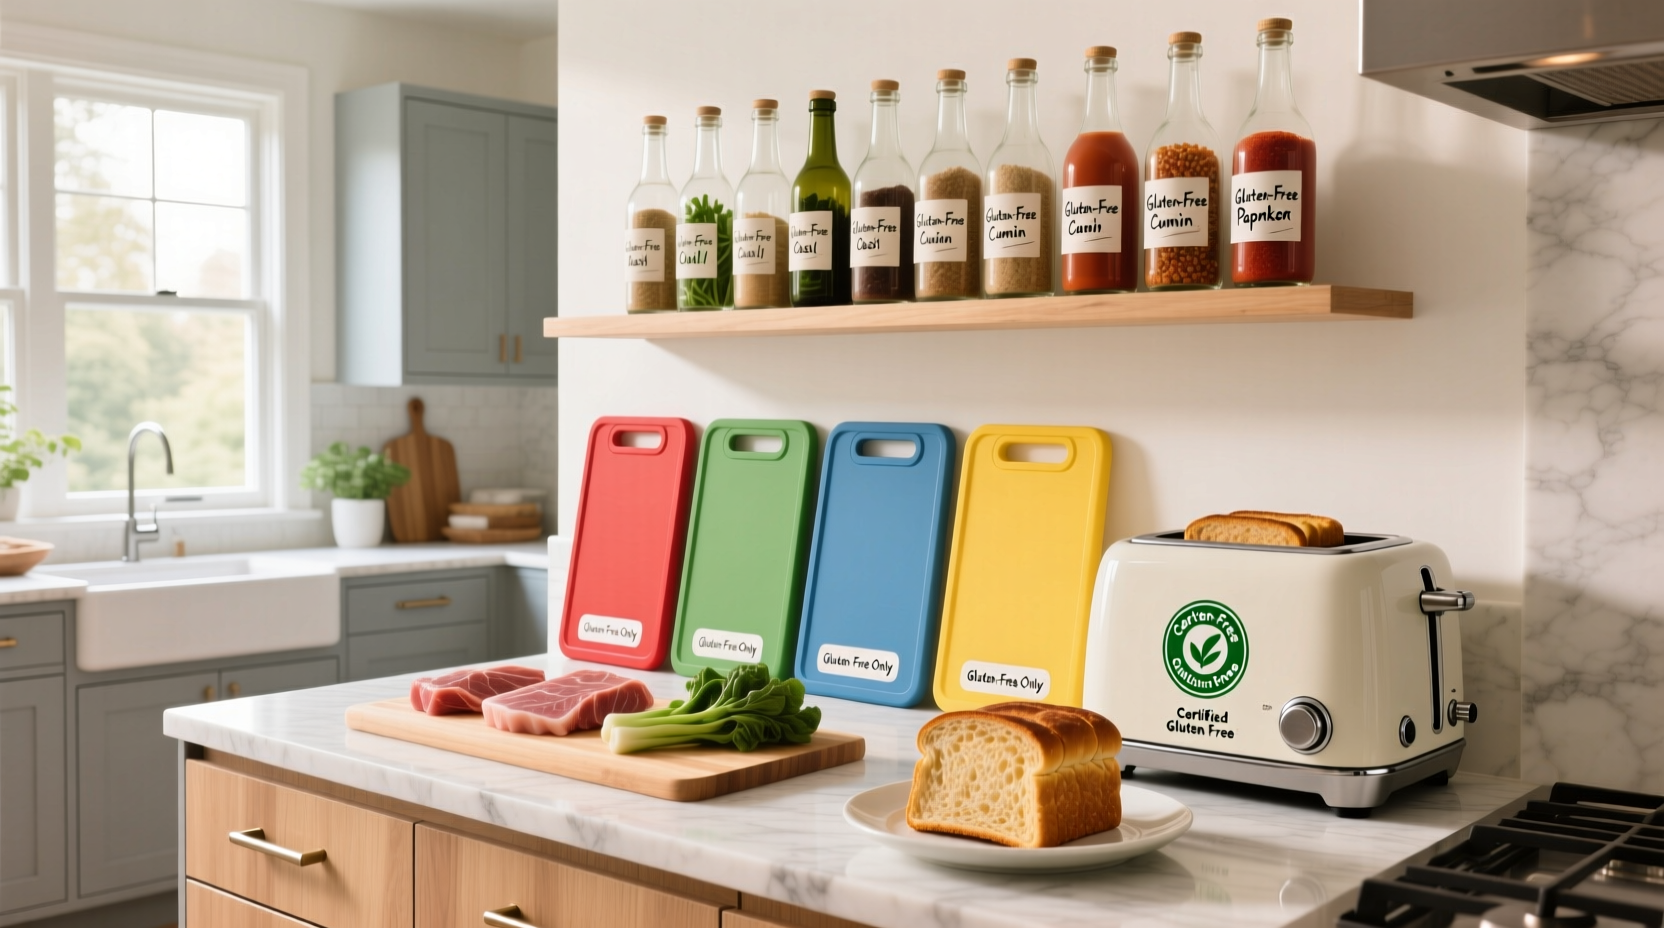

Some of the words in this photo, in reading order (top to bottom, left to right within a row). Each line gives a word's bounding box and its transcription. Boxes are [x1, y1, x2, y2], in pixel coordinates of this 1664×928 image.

[1146, 191, 1208, 211] Gluten-Free
[1235, 184, 1300, 206] Gluten-Free
[1150, 212, 1194, 231] Cumin
[988, 225, 1027, 242] Cumin
[871, 658, 893, 677] Only
[1208, 724, 1235, 739] Free
